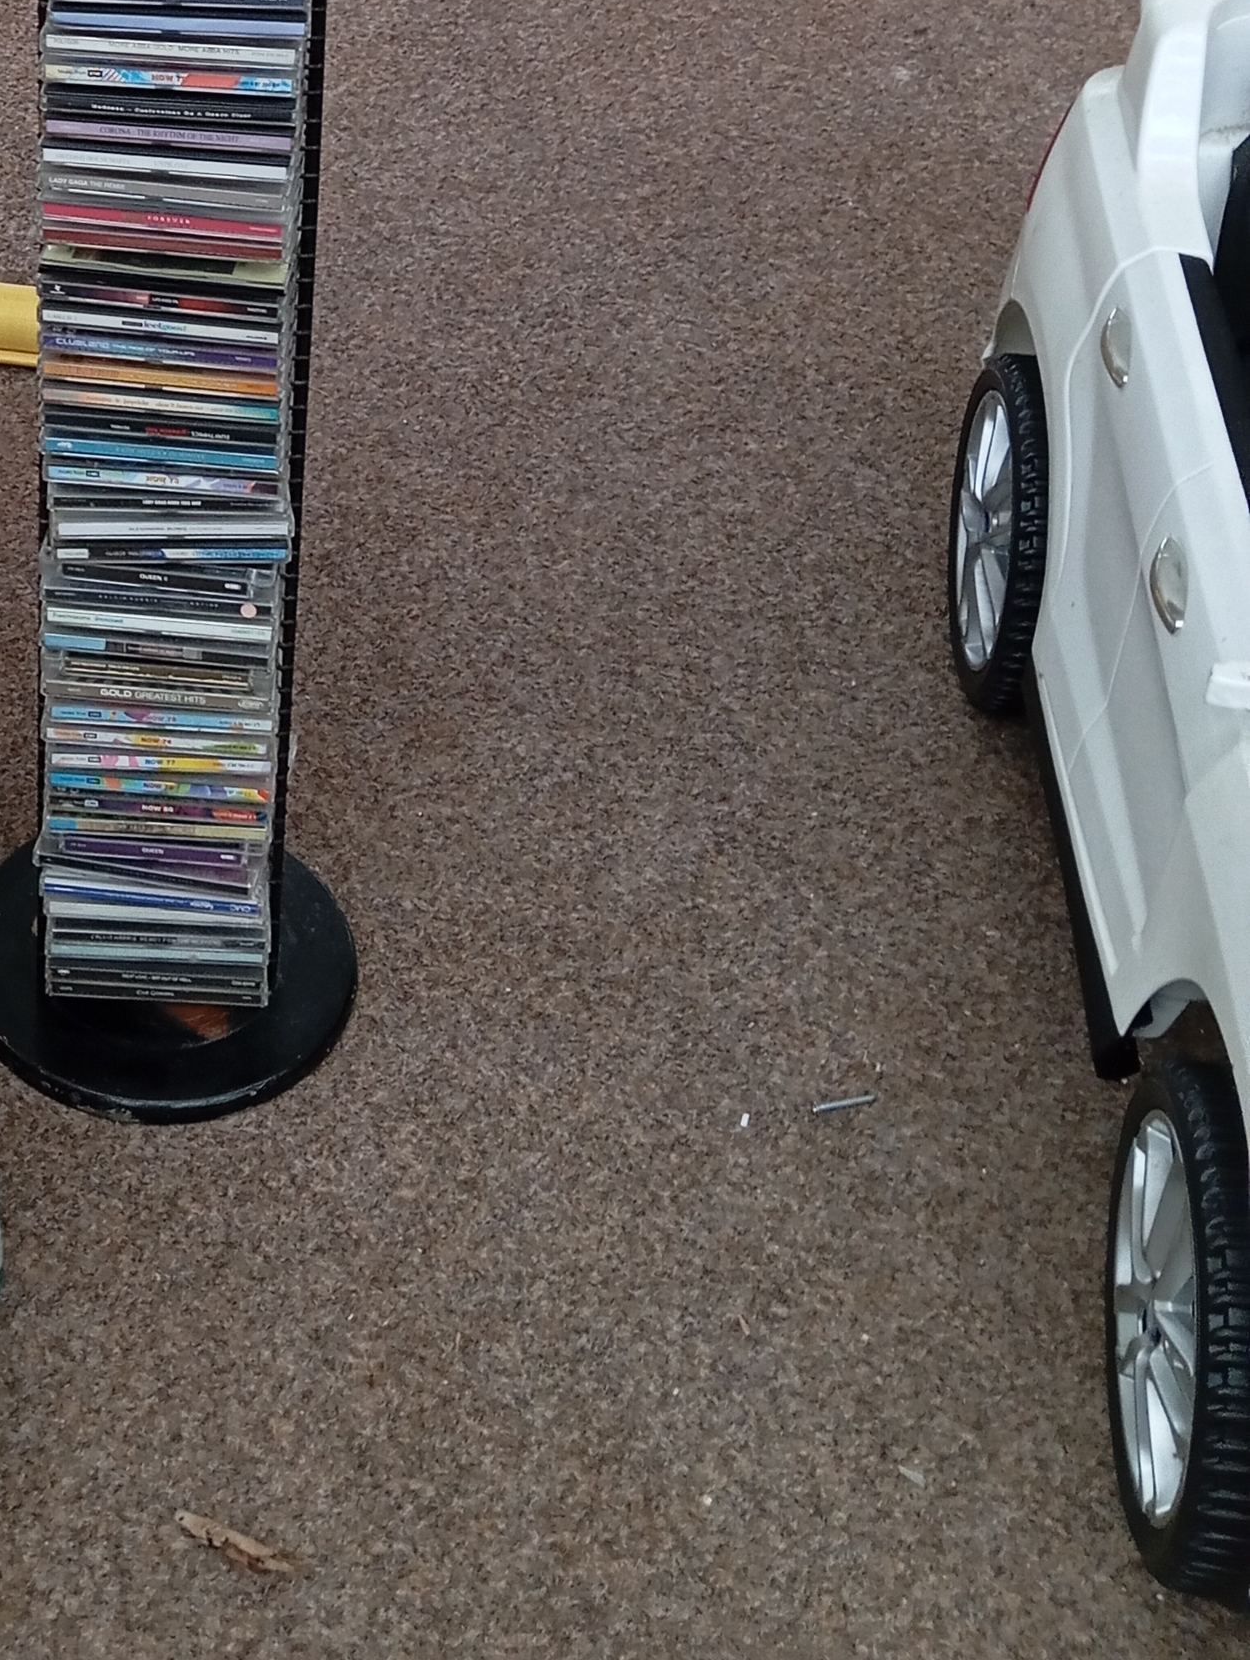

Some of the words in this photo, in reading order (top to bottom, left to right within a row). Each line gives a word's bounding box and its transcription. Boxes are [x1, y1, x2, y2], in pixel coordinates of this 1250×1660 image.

[177, 45, 199, 54] MORE
[99, 126, 132, 136] CORONA
[136, 128, 152, 137] THE
[187, 131, 198, 140] OF
[199, 131, 215, 141] THE
[215, 133, 240, 143] NIGHT
[48, 176, 68, 185] LADY
[68, 178, 89, 187] GAGA
[89, 180, 103, 188] THE
[139, 572, 163, 582] QUEEN
[99, 688, 133, 698] GOLD
[134, 690, 183, 703] GREATEST
[184, 695, 207, 705] HITS
[140, 736, 160, 744] NOW
[144, 758, 164, 766] NOW
[143, 782, 164, 790] NOW
[141, 804, 162, 813] NOW
